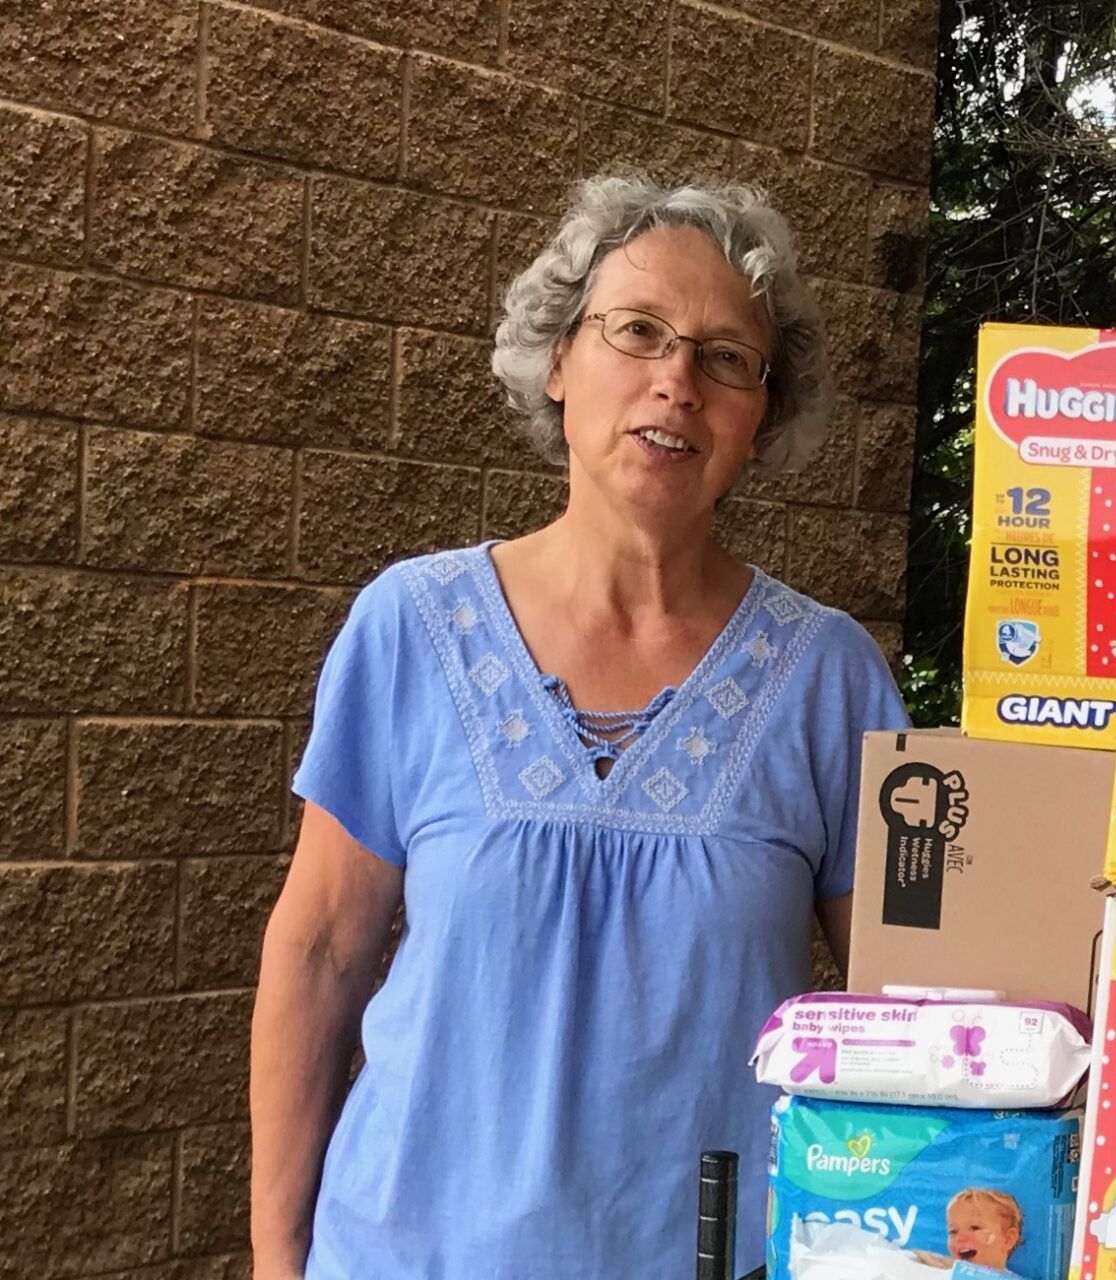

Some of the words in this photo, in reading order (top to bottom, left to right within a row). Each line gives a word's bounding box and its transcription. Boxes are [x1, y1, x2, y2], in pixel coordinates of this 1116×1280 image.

[1028, 442, 1073, 462] Snug
[1074, 446, 1088, 460] &
[1006, 487, 1052, 516] 12
[997, 516, 1050, 529] HOUR
[990, 547, 1060, 566] LONG
[989, 566, 1060, 580] LASTING
[989, 580, 1060, 591] PROTECTION
[1000, 696, 1112, 727] GIANT
[938, 773, 966, 839] PLUS
[909, 836, 921, 882] Wetness
[921, 838, 933, 879] Huggies
[946, 844, 966, 875] AVEC
[794, 1008, 876, 1023] sensitive
[806, 1143, 891, 1177] Pampers
